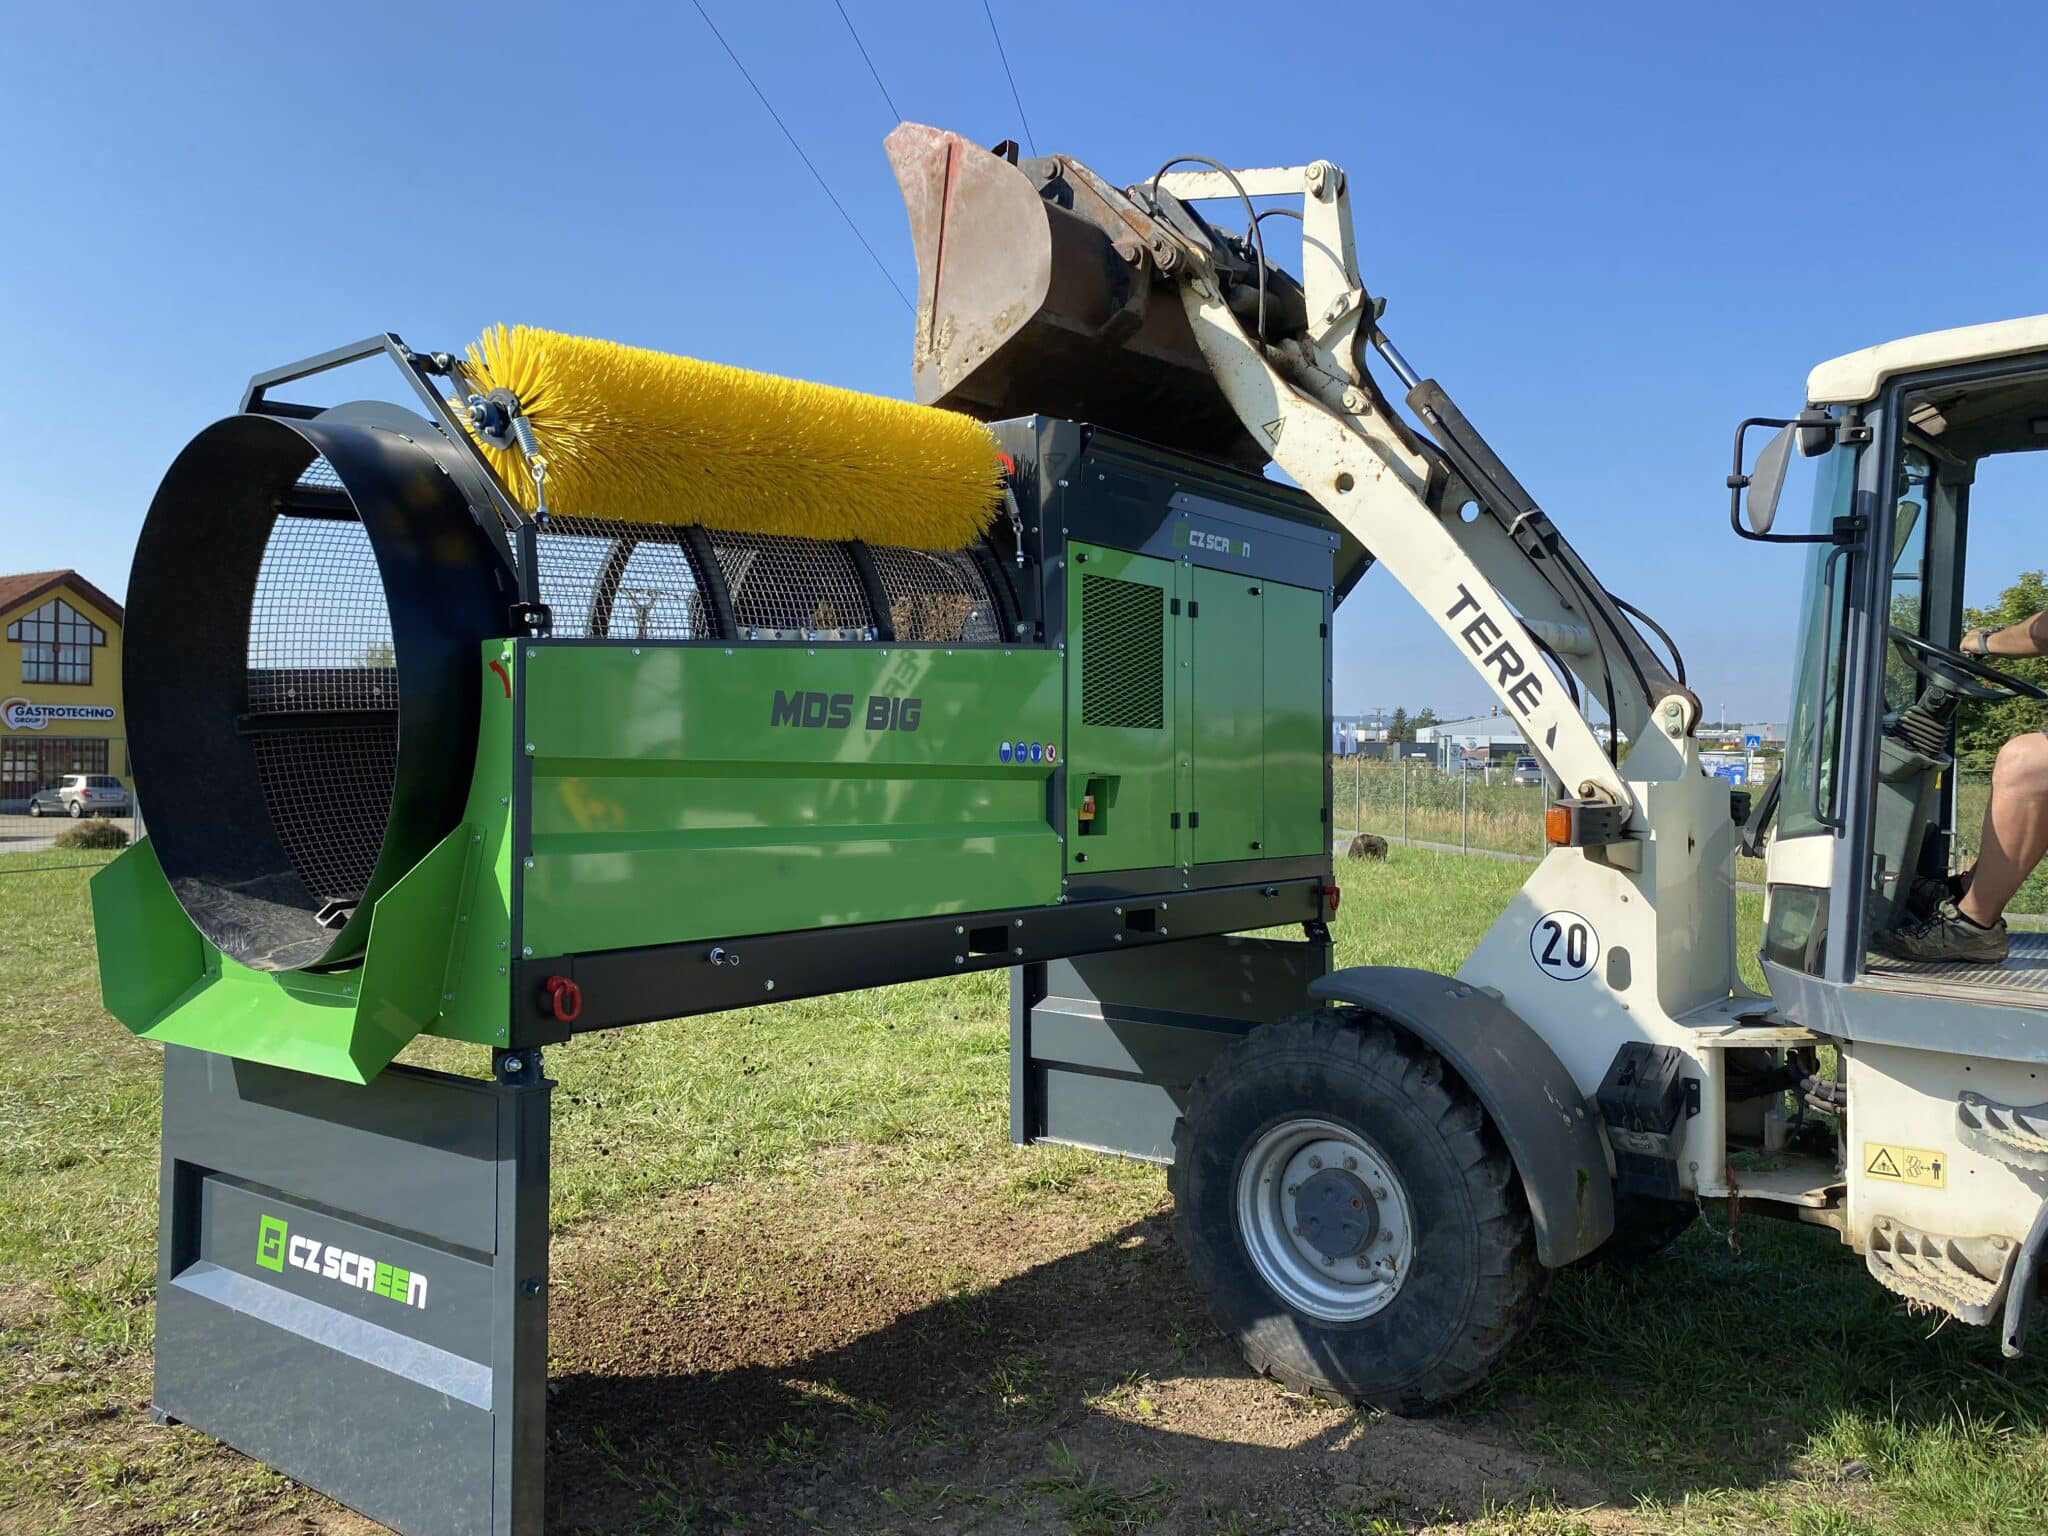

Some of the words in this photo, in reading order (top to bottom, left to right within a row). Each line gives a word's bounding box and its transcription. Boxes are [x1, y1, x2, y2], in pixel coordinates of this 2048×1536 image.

[15, 706, 114, 718] GASTROTECHNO
[770, 690, 854, 729] MDS
[865, 695, 922, 732] BIG
[1542, 920, 1587, 968] 20
